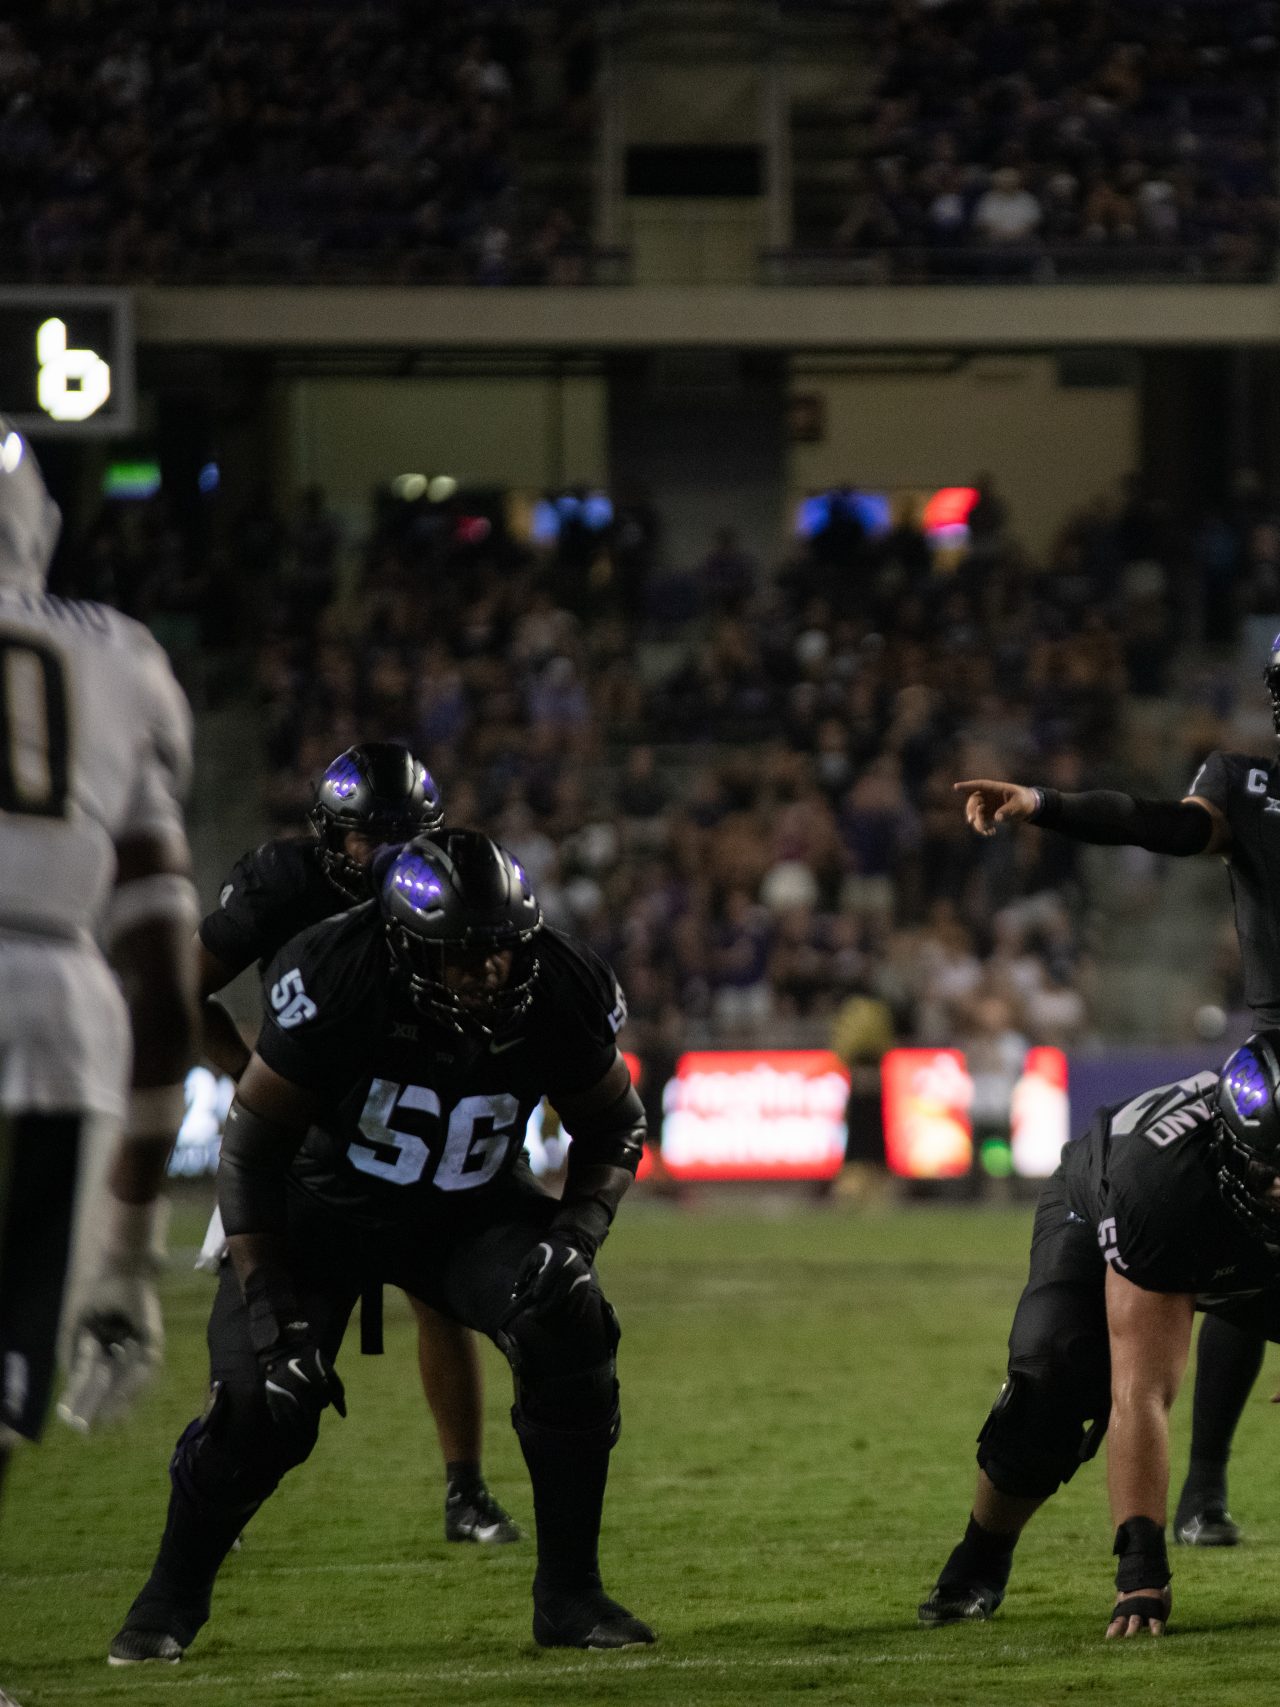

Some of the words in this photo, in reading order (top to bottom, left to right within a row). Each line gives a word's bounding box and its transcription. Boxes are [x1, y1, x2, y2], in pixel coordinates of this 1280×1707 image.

[1247, 768, 1268, 793] C
[271, 968, 318, 1030] 56
[346, 1077, 521, 1192] 56
